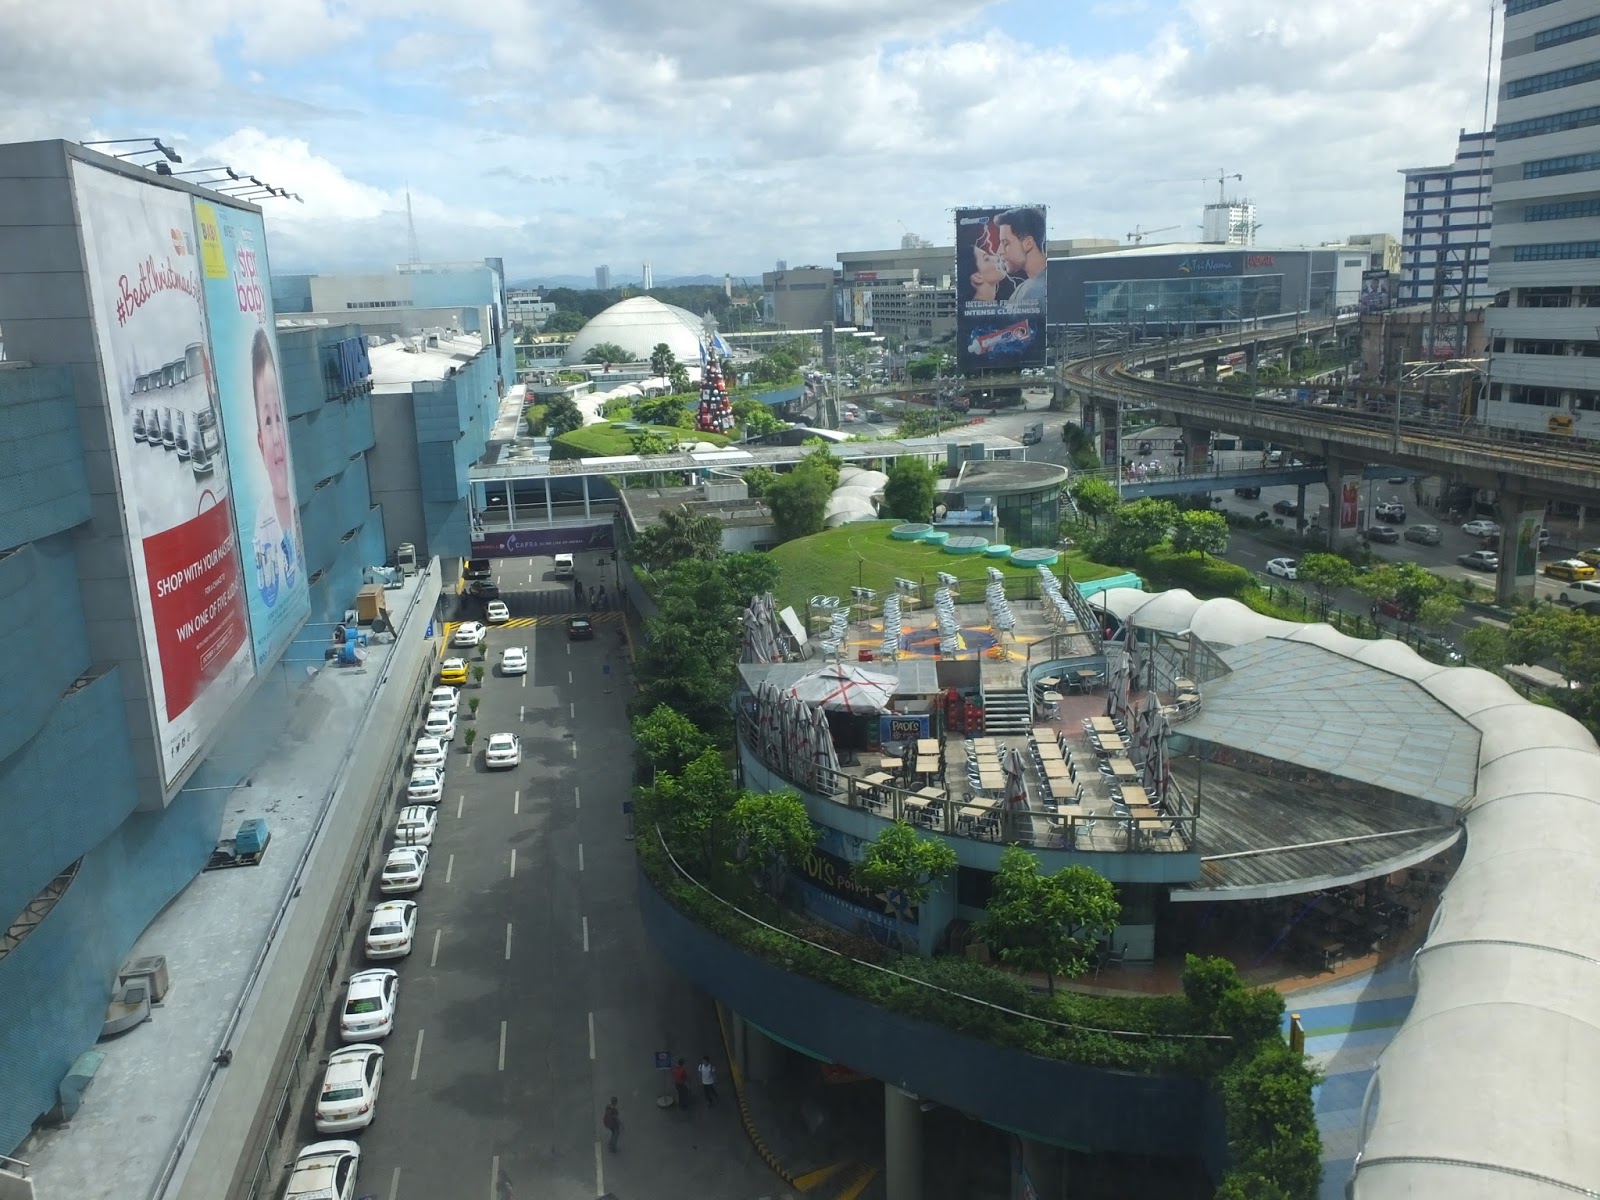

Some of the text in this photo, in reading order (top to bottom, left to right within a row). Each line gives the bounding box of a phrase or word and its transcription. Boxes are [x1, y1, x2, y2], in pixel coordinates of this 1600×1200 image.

[965, 300, 998, 308] INTENSE
[964, 307, 1041, 316] INTENSE CLOSENESS
[515, 541, 538, 549] CAPRA
[157, 571, 184, 598] SHOP
[183, 561, 204, 584] WITH
[202, 549, 219, 572] YOUR
[176, 620, 194, 643] WIN
[194, 608, 210, 632] ONE
[209, 601, 218, 620] OF
[217, 592, 228, 612] FIVE
[892, 720, 919, 731] PADI'S
